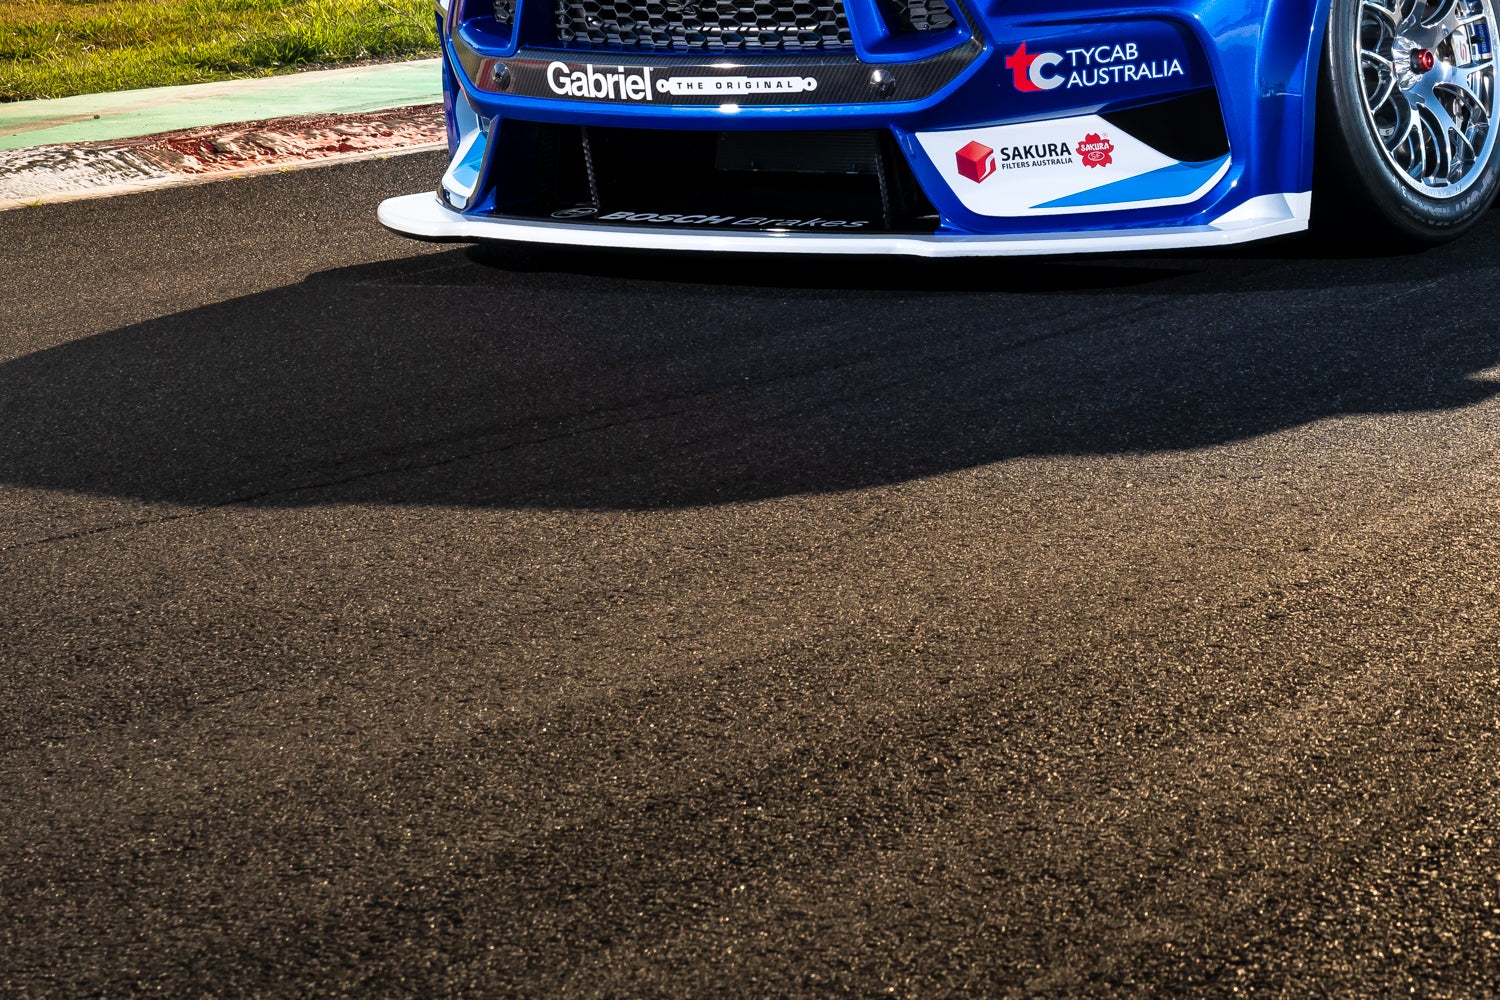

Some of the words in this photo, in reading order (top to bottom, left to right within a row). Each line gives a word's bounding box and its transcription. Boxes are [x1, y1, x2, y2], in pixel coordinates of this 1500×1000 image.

[1066, 43, 1139, 67] TYCAB
[547, 61, 653, 100] Gabriel
[1066, 58, 1184, 89] AUSTRALIA
[676, 81, 704, 90] THE
[715, 81, 793, 90] ORIGINAL
[1000, 142, 1072, 162] SAKURA
[1080, 142, 1110, 152] SAKURA
[1001, 160, 1031, 170] FILTERS
[1031, 157, 1073, 167] AUSTRALIA
[599, 211, 737, 224] BOSCH
[732, 217, 870, 228] Brakes
